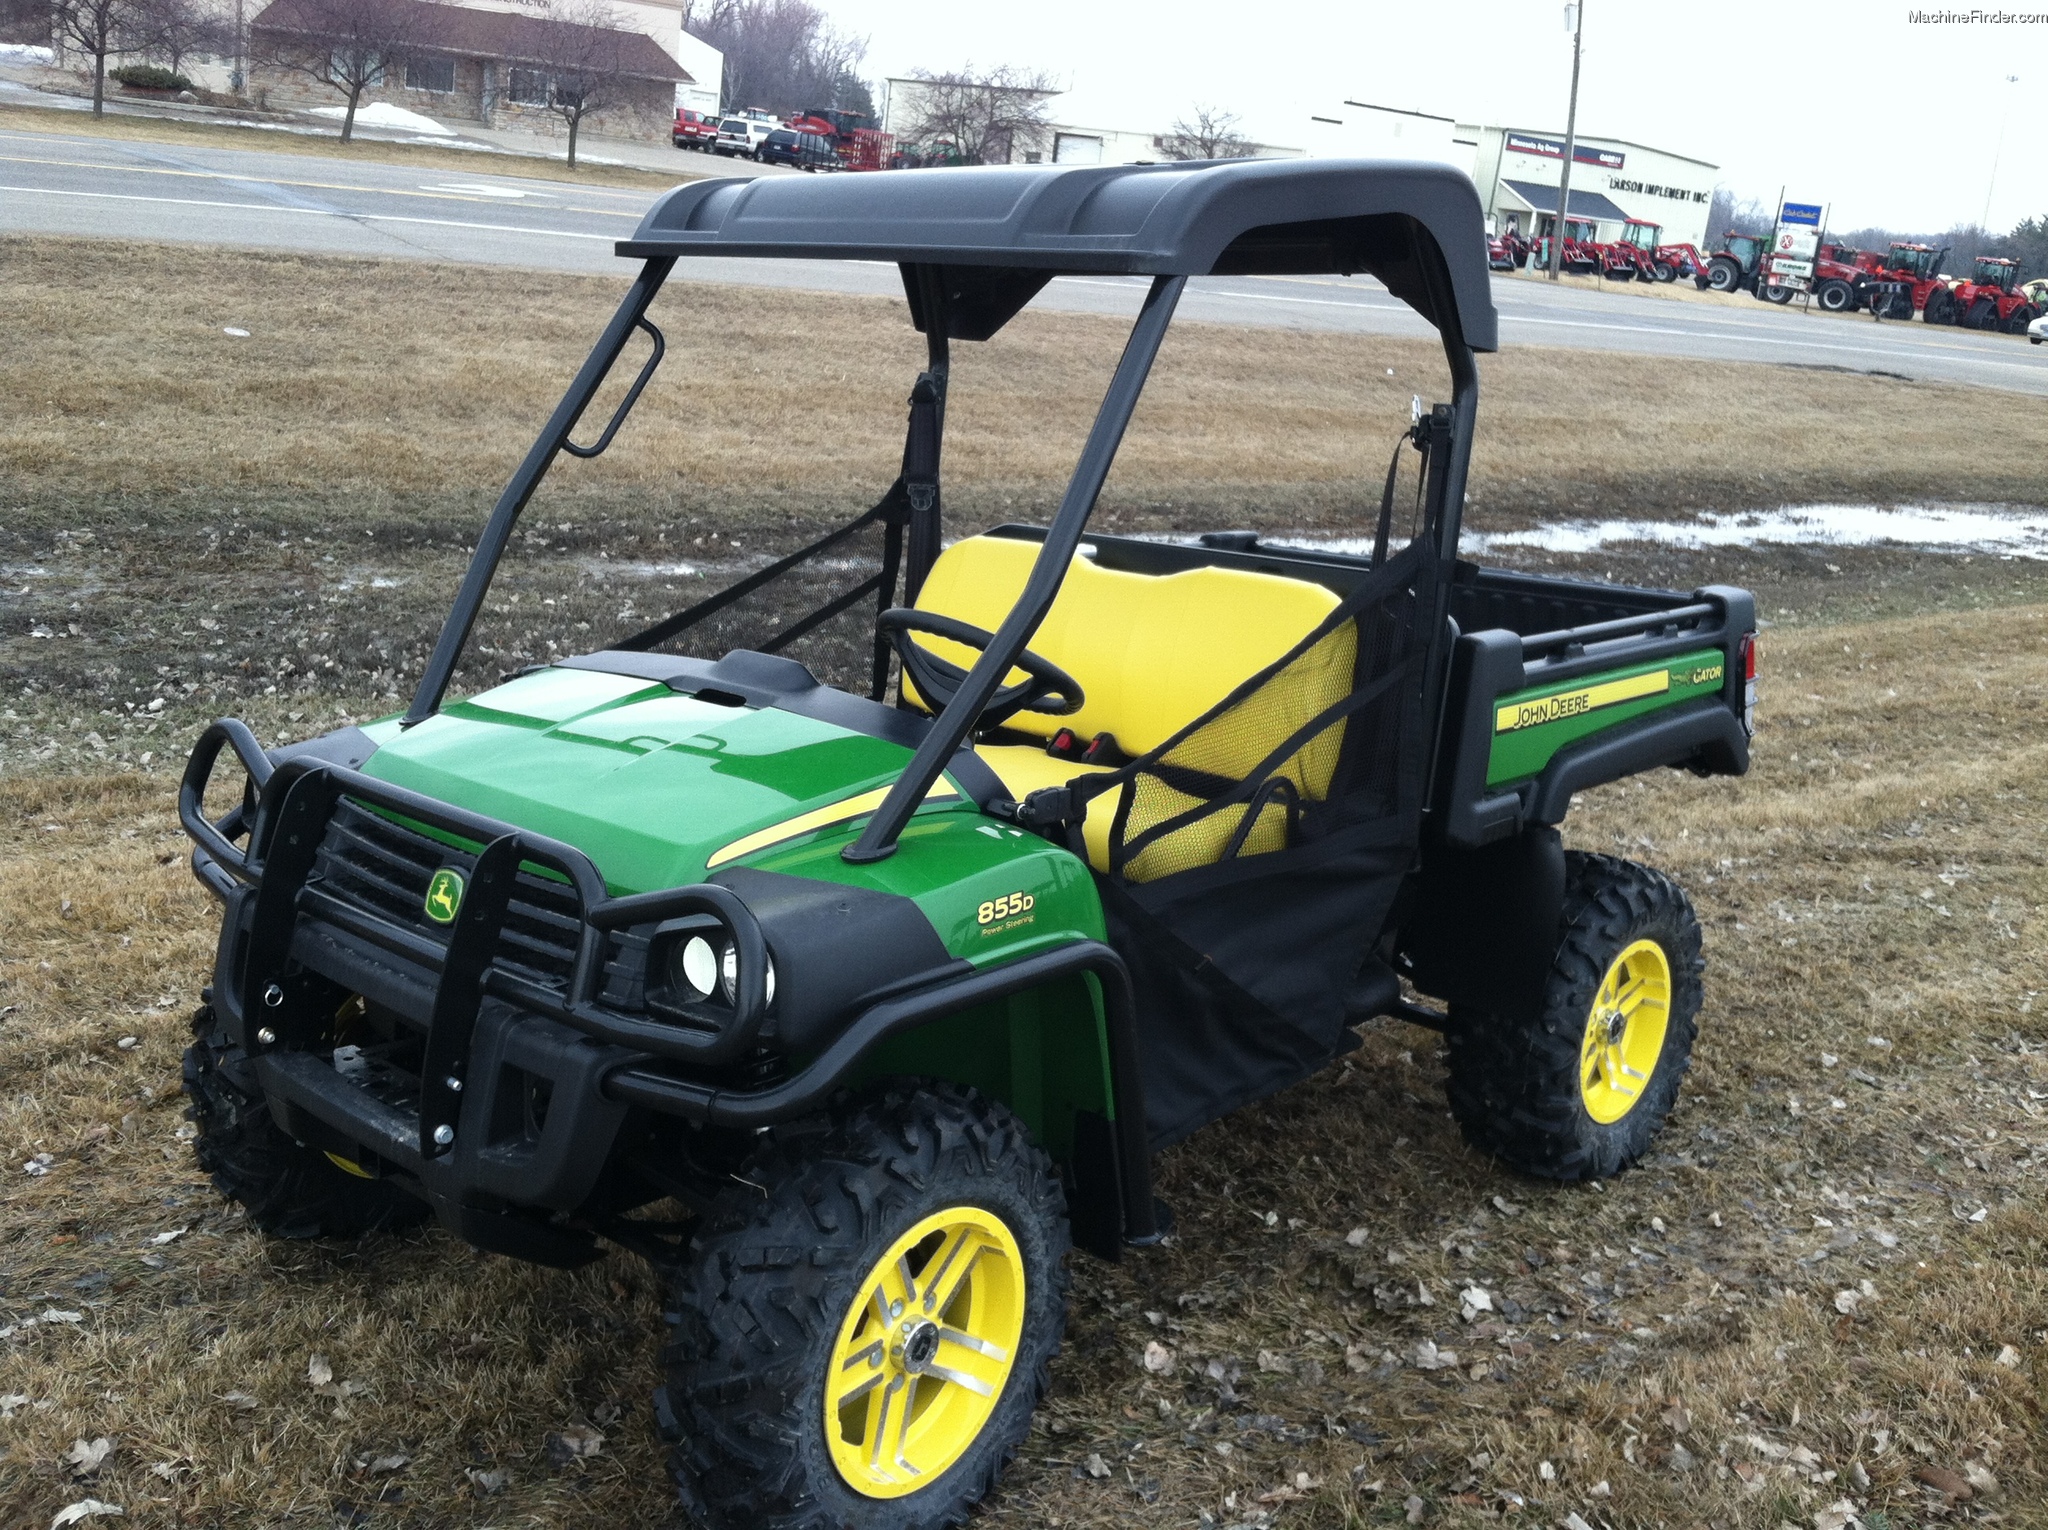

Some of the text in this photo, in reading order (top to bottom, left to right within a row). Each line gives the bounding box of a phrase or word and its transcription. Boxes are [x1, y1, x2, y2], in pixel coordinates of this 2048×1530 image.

[495, 0, 551, 9] UCTION
[1609, 177, 1644, 194] LARSON
[1644, 183, 1691, 201] IMPLEMENT
[1693, 665, 1722, 684] GATOR
[1514, 694, 1590, 727] JOHN DEERE
[978, 891, 1035, 924] 855D
[982, 915, 1035, 937] Power Steering
